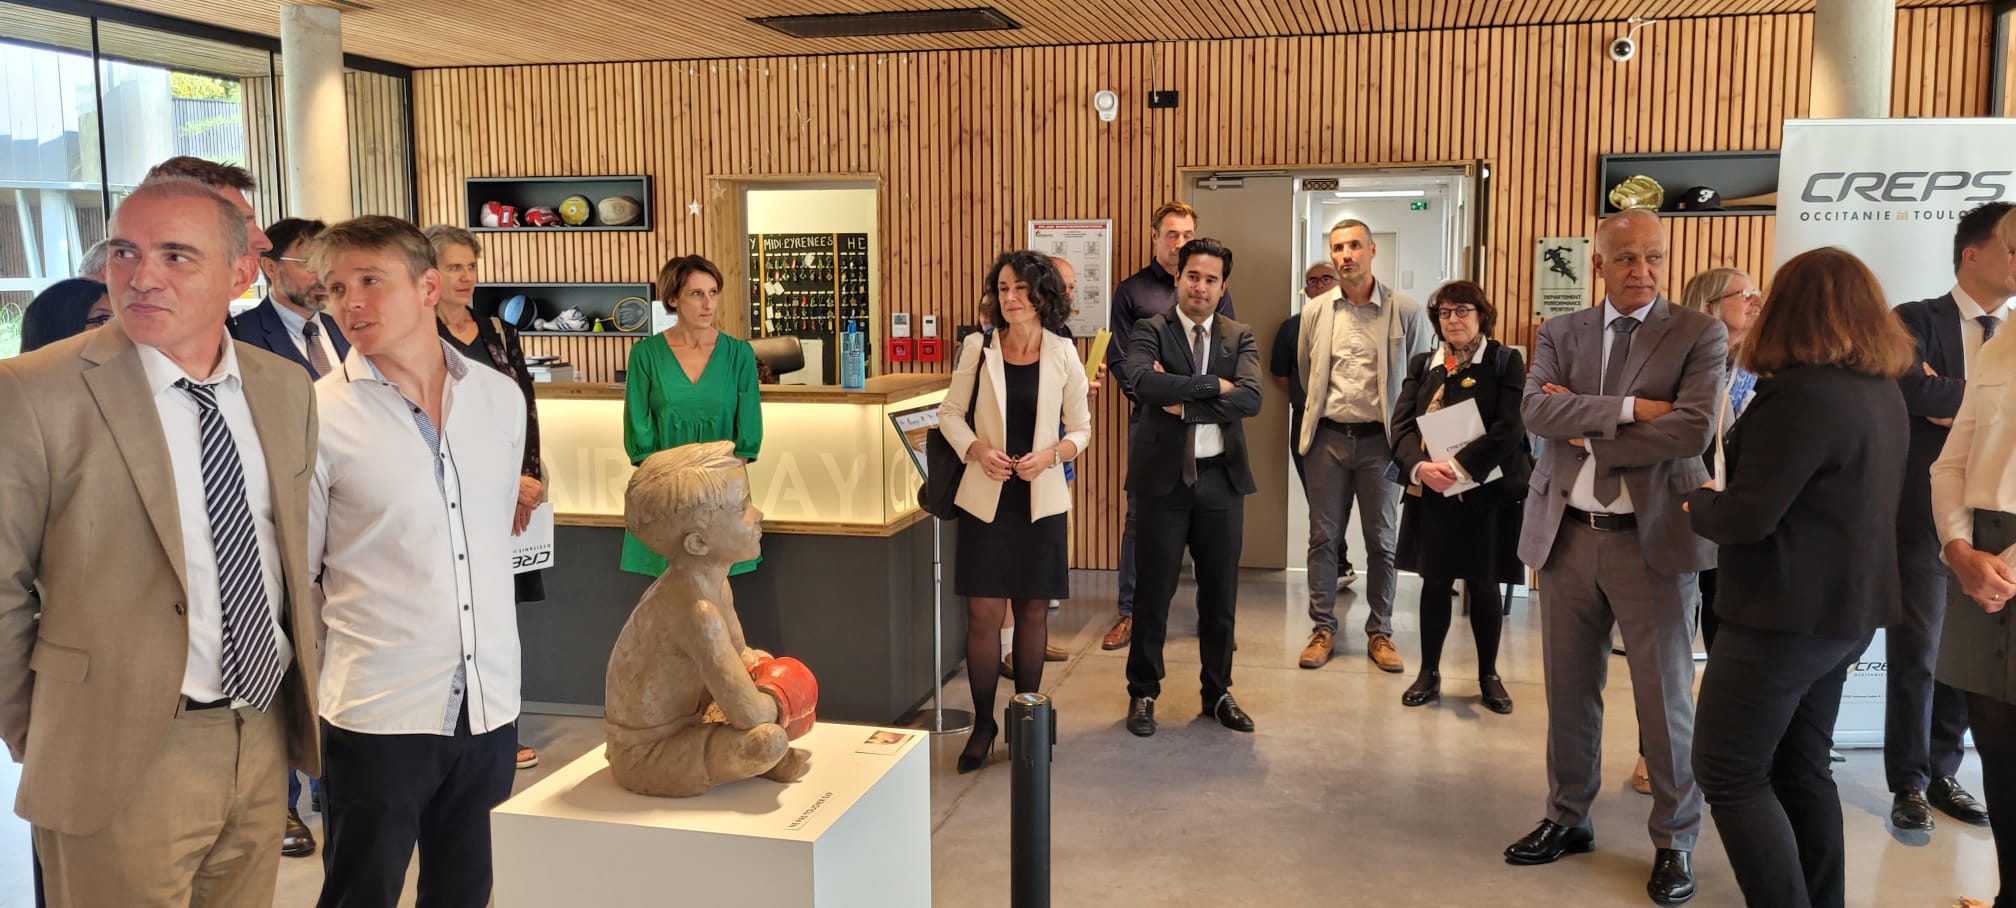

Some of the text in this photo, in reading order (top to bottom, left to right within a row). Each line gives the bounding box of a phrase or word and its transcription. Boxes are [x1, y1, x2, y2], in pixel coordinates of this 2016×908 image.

[1801, 171, 2013, 203] CREPS
[1800, 210, 1969, 221] OCCITANIE TOULO
[762, 453, 866, 520] AY
[512, 551, 551, 569] CRE
[1855, 662, 1887, 671] CRE
